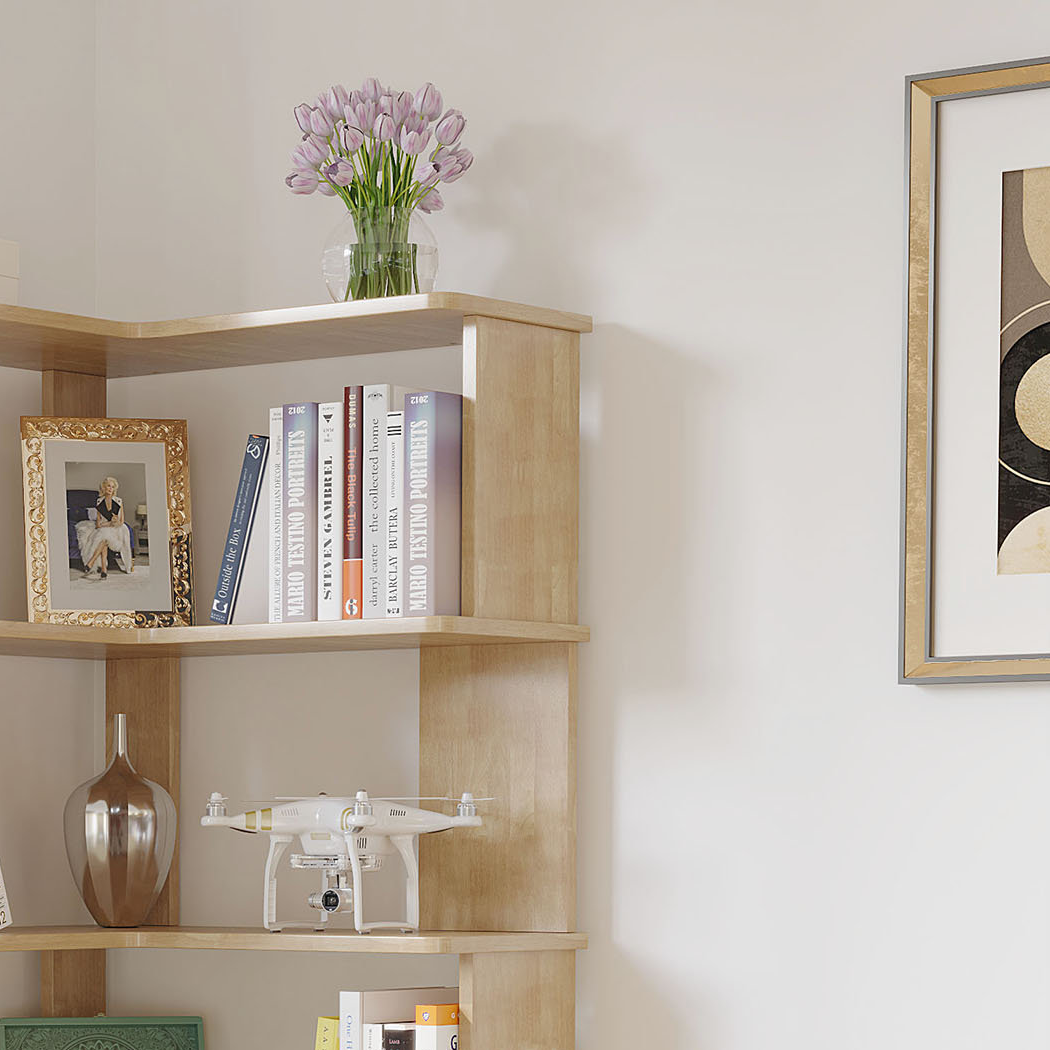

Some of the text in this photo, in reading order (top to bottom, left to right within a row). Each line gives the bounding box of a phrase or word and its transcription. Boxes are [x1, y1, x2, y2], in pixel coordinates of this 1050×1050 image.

[288, 406, 306, 415] 2012
[348, 393, 356, 429] DUMAS
[410, 395, 429, 405] 2012
[345, 447, 357, 541] The Black Tulip
[369, 418, 379, 533] the collected home
[229, 529, 241, 545] Box
[287, 511, 305, 567] TESTINO
[323, 456, 333, 600] STEVEN GAMBREL
[388, 507, 398, 549] BUTERA
[409, 503, 428, 560] TESTINO
[226, 547, 237, 562] the
[218, 564, 233, 598] Outside
[287, 571, 305, 616] MARIO
[369, 576, 381, 607] darryl
[388, 556, 398, 602] BARCLAY
[409, 565, 428, 611] MARIO
